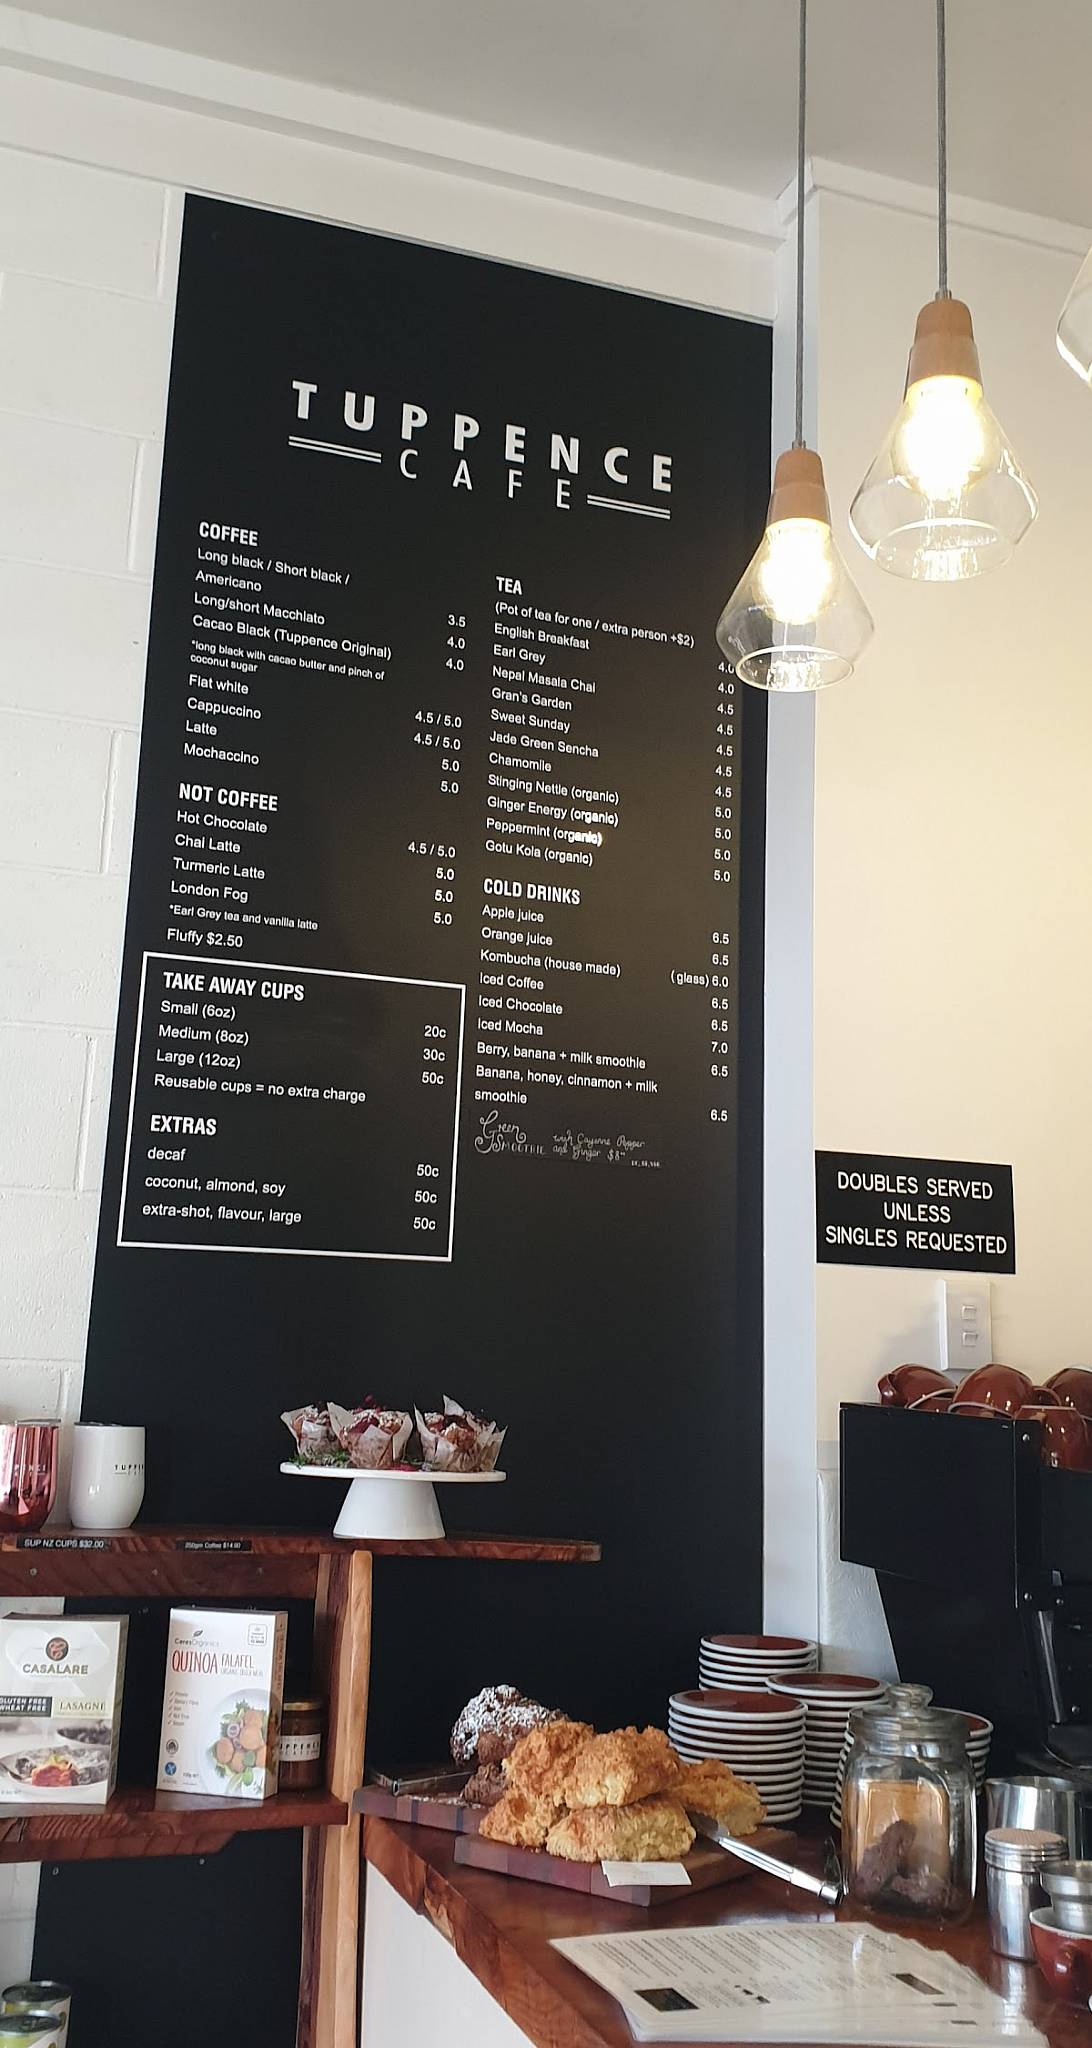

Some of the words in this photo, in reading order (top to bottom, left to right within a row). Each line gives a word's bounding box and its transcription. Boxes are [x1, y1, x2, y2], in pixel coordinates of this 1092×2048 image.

[292, 380, 672, 492] TUPPENCE
[400, 448, 571, 509] CAFE
[199, 521, 258, 547] COFFEE
[197, 548, 228, 566] Long
[232, 553, 264, 571] black
[275, 562, 308, 578] Short
[195, 571, 262, 591] Americano
[496, 576, 522, 595] TEA
[194, 592, 260, 615] Long/short
[263, 604, 325, 625] Macchiato
[448, 614, 466, 627] 3.5
[495, 601, 518, 618] (Pot
[554, 612, 569, 624] for
[572, 618, 592, 629] one
[631, 628, 667, 642] person
[670, 634, 695, 648] +$2)
[193, 615, 233, 632] Cacao
[237, 623, 271, 638] Black
[274, 628, 338, 650] (Tuppence
[341, 640, 392, 660] Original)
[447, 636, 465, 649] 4.0
[494, 623, 534, 640] English
[538, 630, 590, 650] Breakfast
[494, 644, 516, 658] Earl
[190, 654, 229, 667] coconut
[231, 661, 258, 673] sugar
[247, 650, 266, 661] with
[268, 654, 297, 666] cacao
[299, 658, 326, 671] butter
[328, 663, 346, 674] and
[348, 666, 373, 679] pinch
[375, 671, 385, 680] of
[189, 674, 213, 689] Flat
[216, 680, 249, 694] white
[492, 666, 525, 682] Nepal
[528, 672, 567, 689] Masala
[187, 698, 262, 719] Cappuccino
[492, 687, 528, 704] Gran's
[532, 694, 572, 710] Garden
[717, 703, 734, 715] 4.5
[186, 720, 217, 736] Latte
[415, 711, 434, 724] 4.5
[436, 714, 441, 725] /
[444, 715, 462, 728] 5.0
[490, 709, 526, 725] Sweet
[529, 715, 570, 734] Sunday
[490, 730, 517, 746] Jade
[520, 736, 554, 752] Green
[558, 741, 599, 757] Sencha
[184, 743, 260, 765] Mochaccino
[489, 752, 552, 772] Chamomile
[441, 759, 460, 772] 5.0
[179, 783, 213, 801] NOT
[218, 789, 278, 812] COFFEE
[488, 774, 532, 792] Stinging
[536, 782, 568, 796] Nettle
[571, 786, 619, 805] (organic)
[488, 796, 524, 814] Ginger
[528, 802, 567, 820] Energy
[177, 810, 199, 824] Hot
[204, 815, 267, 833] Chocolate
[486, 818, 550, 838] Peppermint
[175, 834, 205, 849] Chai
[486, 840, 512, 854] Gotu
[516, 845, 541, 858] Kola
[173, 857, 230, 875] Turmeric
[171, 881, 219, 898] London
[224, 888, 248, 903] Fog
[484, 878, 522, 898] COLD
[527, 883, 580, 906] DRINKS
[197, 907, 221, 921] Grey
[224, 910, 240, 922] tea
[242, 913, 261, 924] and
[264, 916, 294, 928] vanilla
[297, 919, 318, 931] latte
[482, 904, 514, 920] Apple
[517, 910, 544, 922] juice
[167, 929, 203, 946] Fluffy
[207, 933, 243, 948] $2.50
[482, 927, 523, 944] Orange
[712, 932, 730, 944] 6.5
[480, 950, 541, 967] Kombucha
[544, 956, 582, 972] (house
[586, 961, 621, 978] made)
[163, 972, 204, 991] TAKE
[209, 977, 256, 996] AWAY
[261, 981, 304, 1000] CUPS
[480, 972, 504, 986] Iced
[507, 975, 544, 990] Coffee
[712, 976, 728, 988] 6.0
[161, 1001, 198, 1016] Small
[202, 1004, 236, 1020] (6oz)
[159, 1025, 211, 1041] Medium
[216, 1029, 249, 1045] (8oz)
[424, 1025, 447, 1038] 20c
[505, 1020, 543, 1036] Mocha
[423, 1049, 445, 1061] 30c
[477, 1042, 510, 1058] Berry,
[514, 1046, 556, 1061] banana
[570, 1052, 592, 1064] milk
[596, 1054, 646, 1069] smoothie
[711, 1042, 728, 1054] 7.0
[157, 1050, 194, 1066] Large
[199, 1053, 241, 1069] (12oz)
[422, 1072, 444, 1085] 50c
[476, 1065, 524, 1082] Banana,
[527, 1070, 564, 1086] honey,
[568, 1074, 622, 1090] cinnamon
[154, 1074, 217, 1091] Reusable
[221, 1081, 252, 1094] cups
[288, 1086, 319, 1099] extra
[323, 1088, 366, 1102] charge
[150, 1115, 217, 1136] EXTRAS
[148, 1147, 186, 1161] decaf
[145, 1176, 201, 1191] coconut,
[206, 1178, 258, 1194] almond,
[262, 1183, 286, 1196] soy
[838, 1171, 918, 1194] DOUBLES
[927, 1178, 993, 1200] SERVED
[142, 1204, 213, 1219] extra-shot,
[218, 1207, 265, 1222] flavour,
[269, 1210, 302, 1224] large
[884, 1202, 950, 1223] UNLESS
[826, 1226, 897, 1247] SINGLES
[906, 1231, 1007, 1254] REQUESTED
[23, 1664, 88, 1674] CASALARE
[172, 1650, 217, 1674] QUINOA
